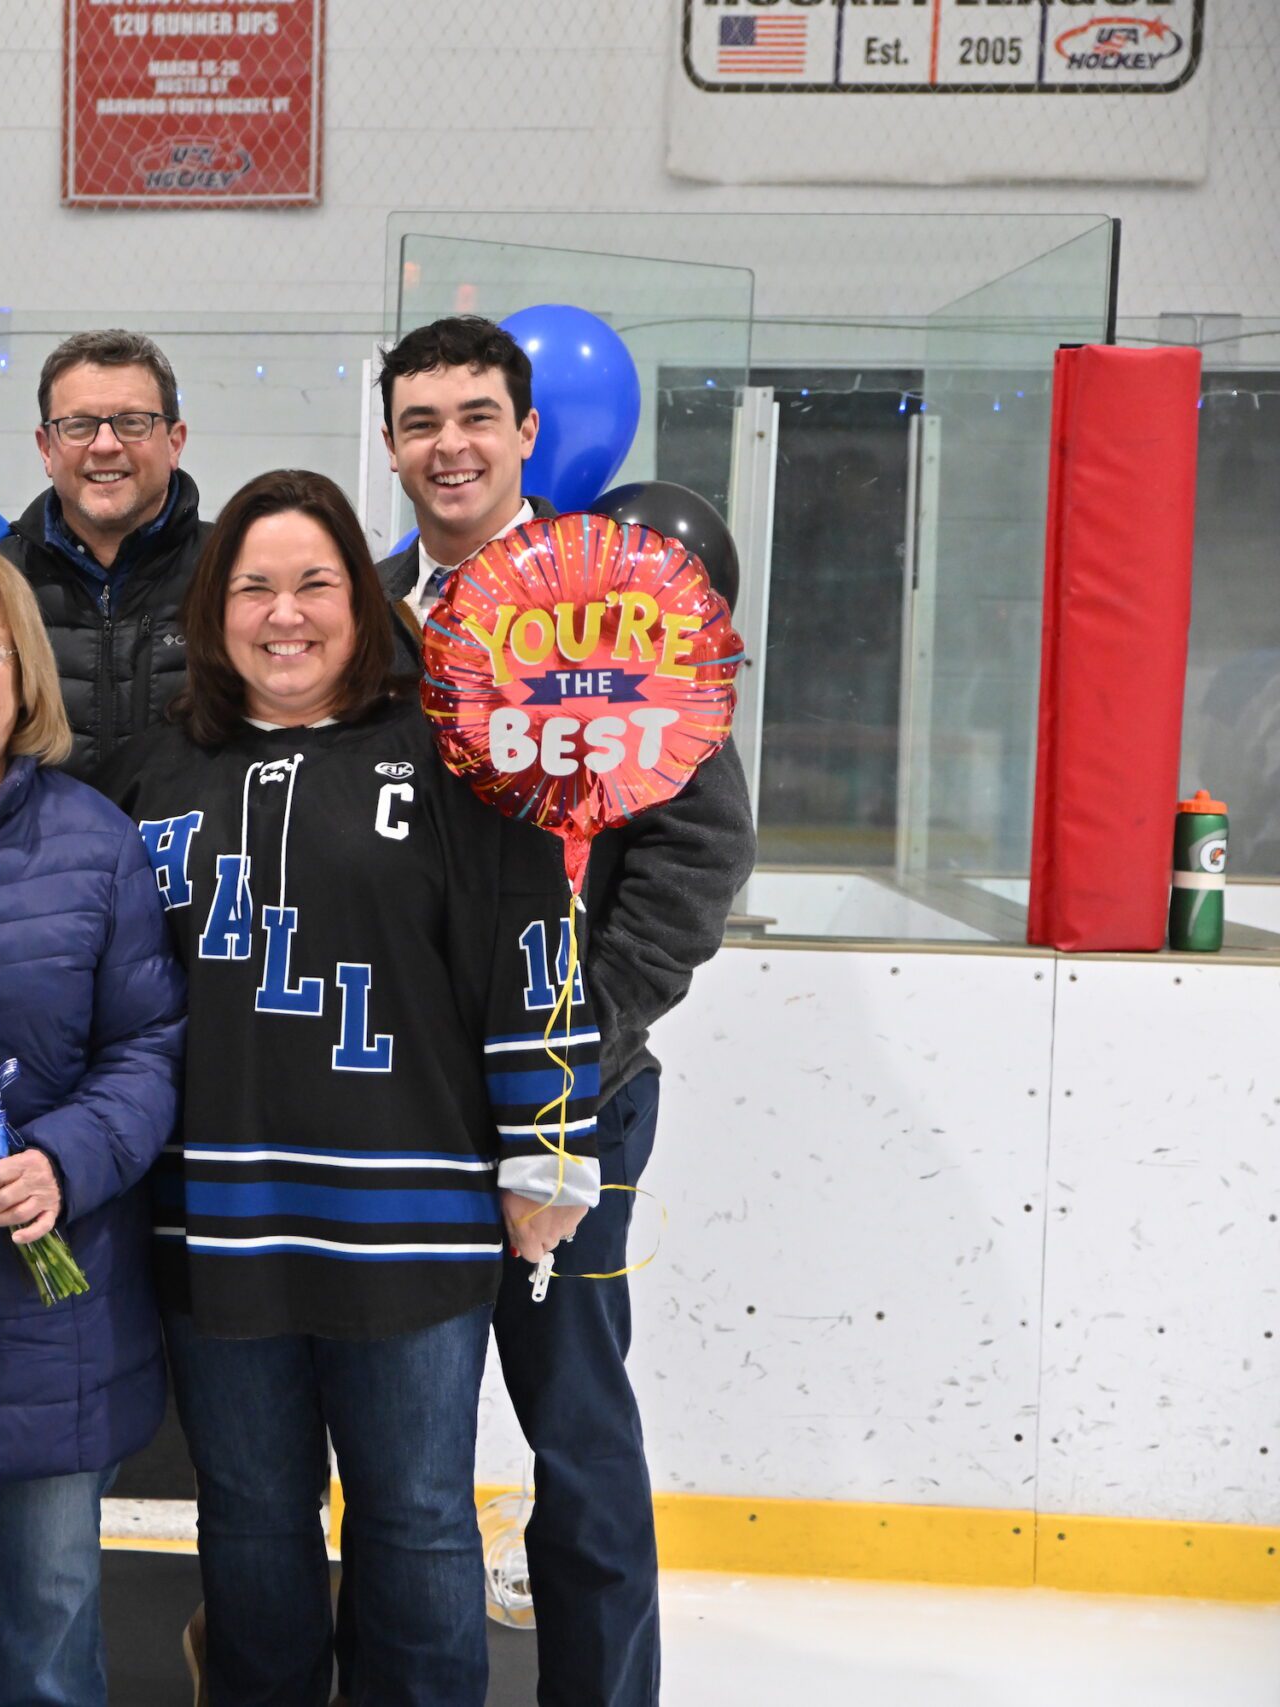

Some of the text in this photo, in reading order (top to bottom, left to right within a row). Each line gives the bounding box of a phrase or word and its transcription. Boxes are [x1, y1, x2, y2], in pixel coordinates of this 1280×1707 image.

[113, 12, 279, 36] 12U RUNNER UPS
[1096, 28, 1139, 45] USA
[865, 38, 1023, 65] Est. 2005
[1069, 53, 1162, 69] HOCKEY
[460, 591, 703, 687] YOU'RE
[556, 672, 613, 695] THE
[489, 707, 680, 776] BEST
[375, 782, 414, 840] C
[1200, 839, 1227, 874] G
